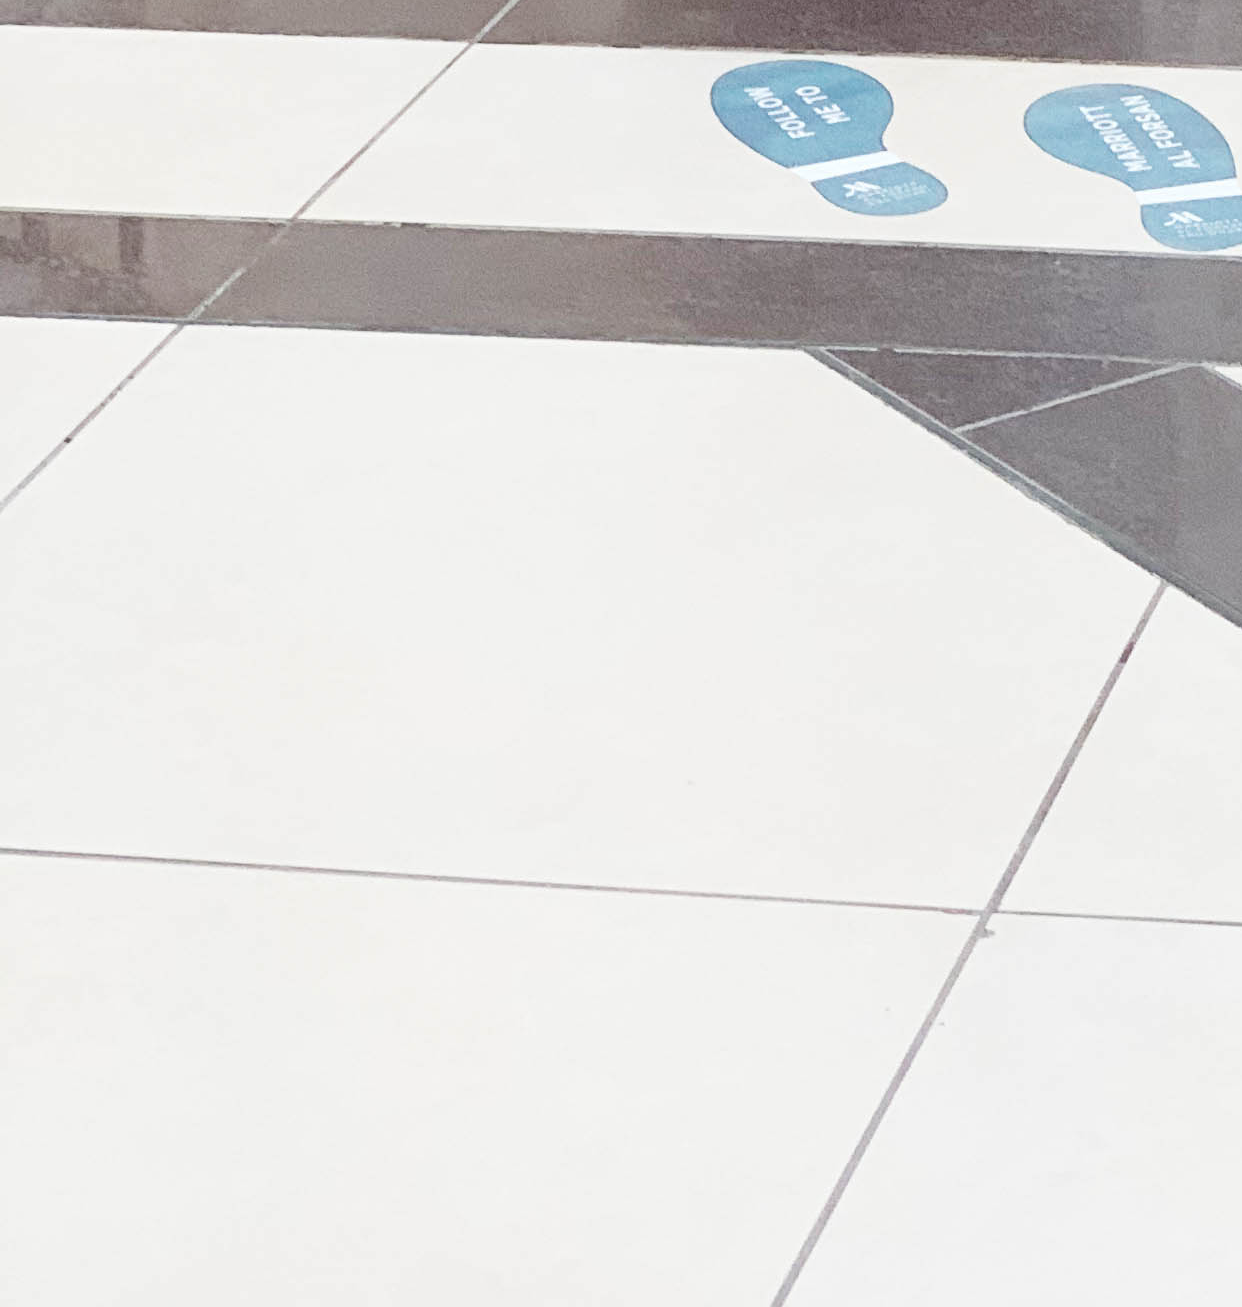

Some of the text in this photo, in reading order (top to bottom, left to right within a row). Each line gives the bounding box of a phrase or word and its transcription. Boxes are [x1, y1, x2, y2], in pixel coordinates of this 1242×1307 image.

[743, 86, 817, 139] FOLLOW
[794, 85, 851, 125] ME TO
[1119, 94, 1200, 168] AL FORSAN
[1079, 106, 1152, 172] MARRIOTT
